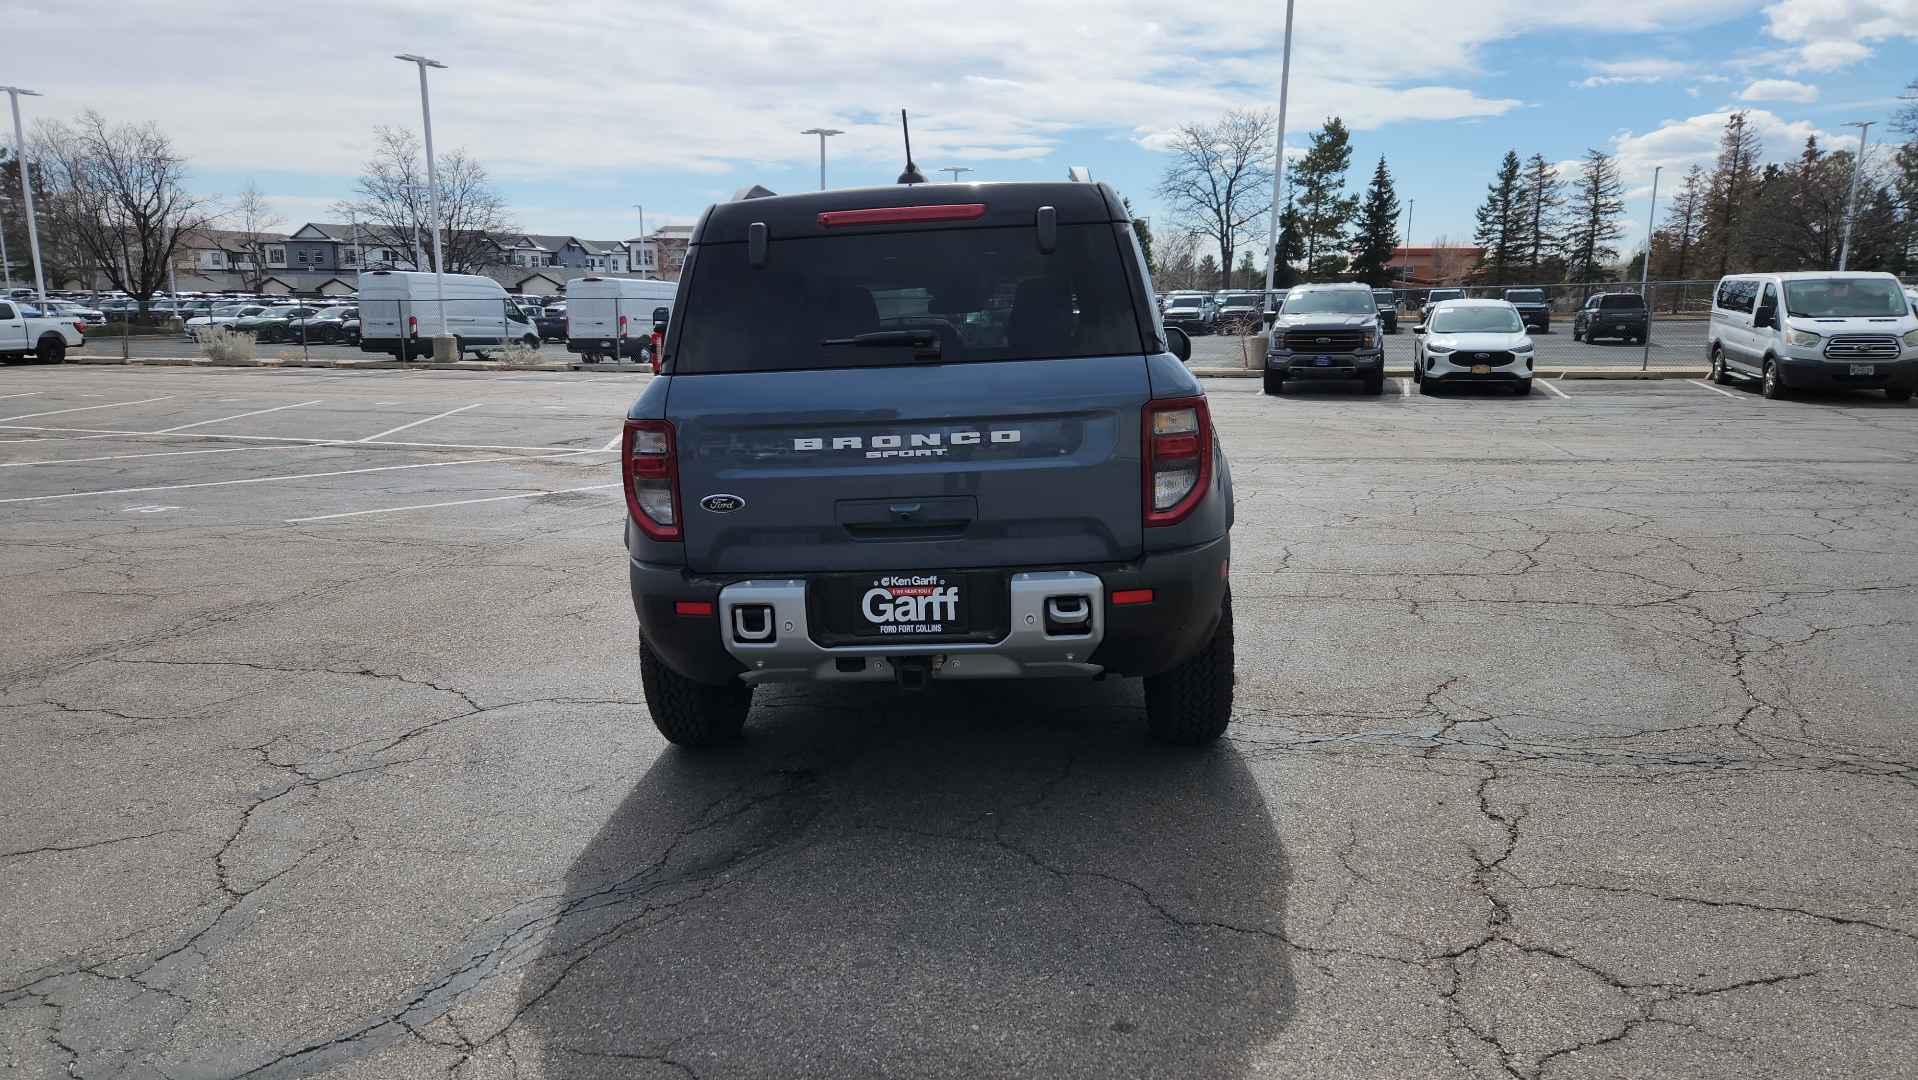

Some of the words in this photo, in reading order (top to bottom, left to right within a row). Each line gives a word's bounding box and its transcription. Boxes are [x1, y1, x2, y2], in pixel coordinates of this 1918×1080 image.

[794, 430, 1021, 450] BRONCO
[865, 448, 948, 458] SPORT
[710, 498, 734, 508] Ford
[891, 576, 911, 586] Ken
[912, 575, 937, 586] Garff
[862, 587, 958, 623] Garff
[880, 625, 897, 633] FORD
[898, 624, 914, 633] FORT
[915, 624, 942, 632] COLLINS
